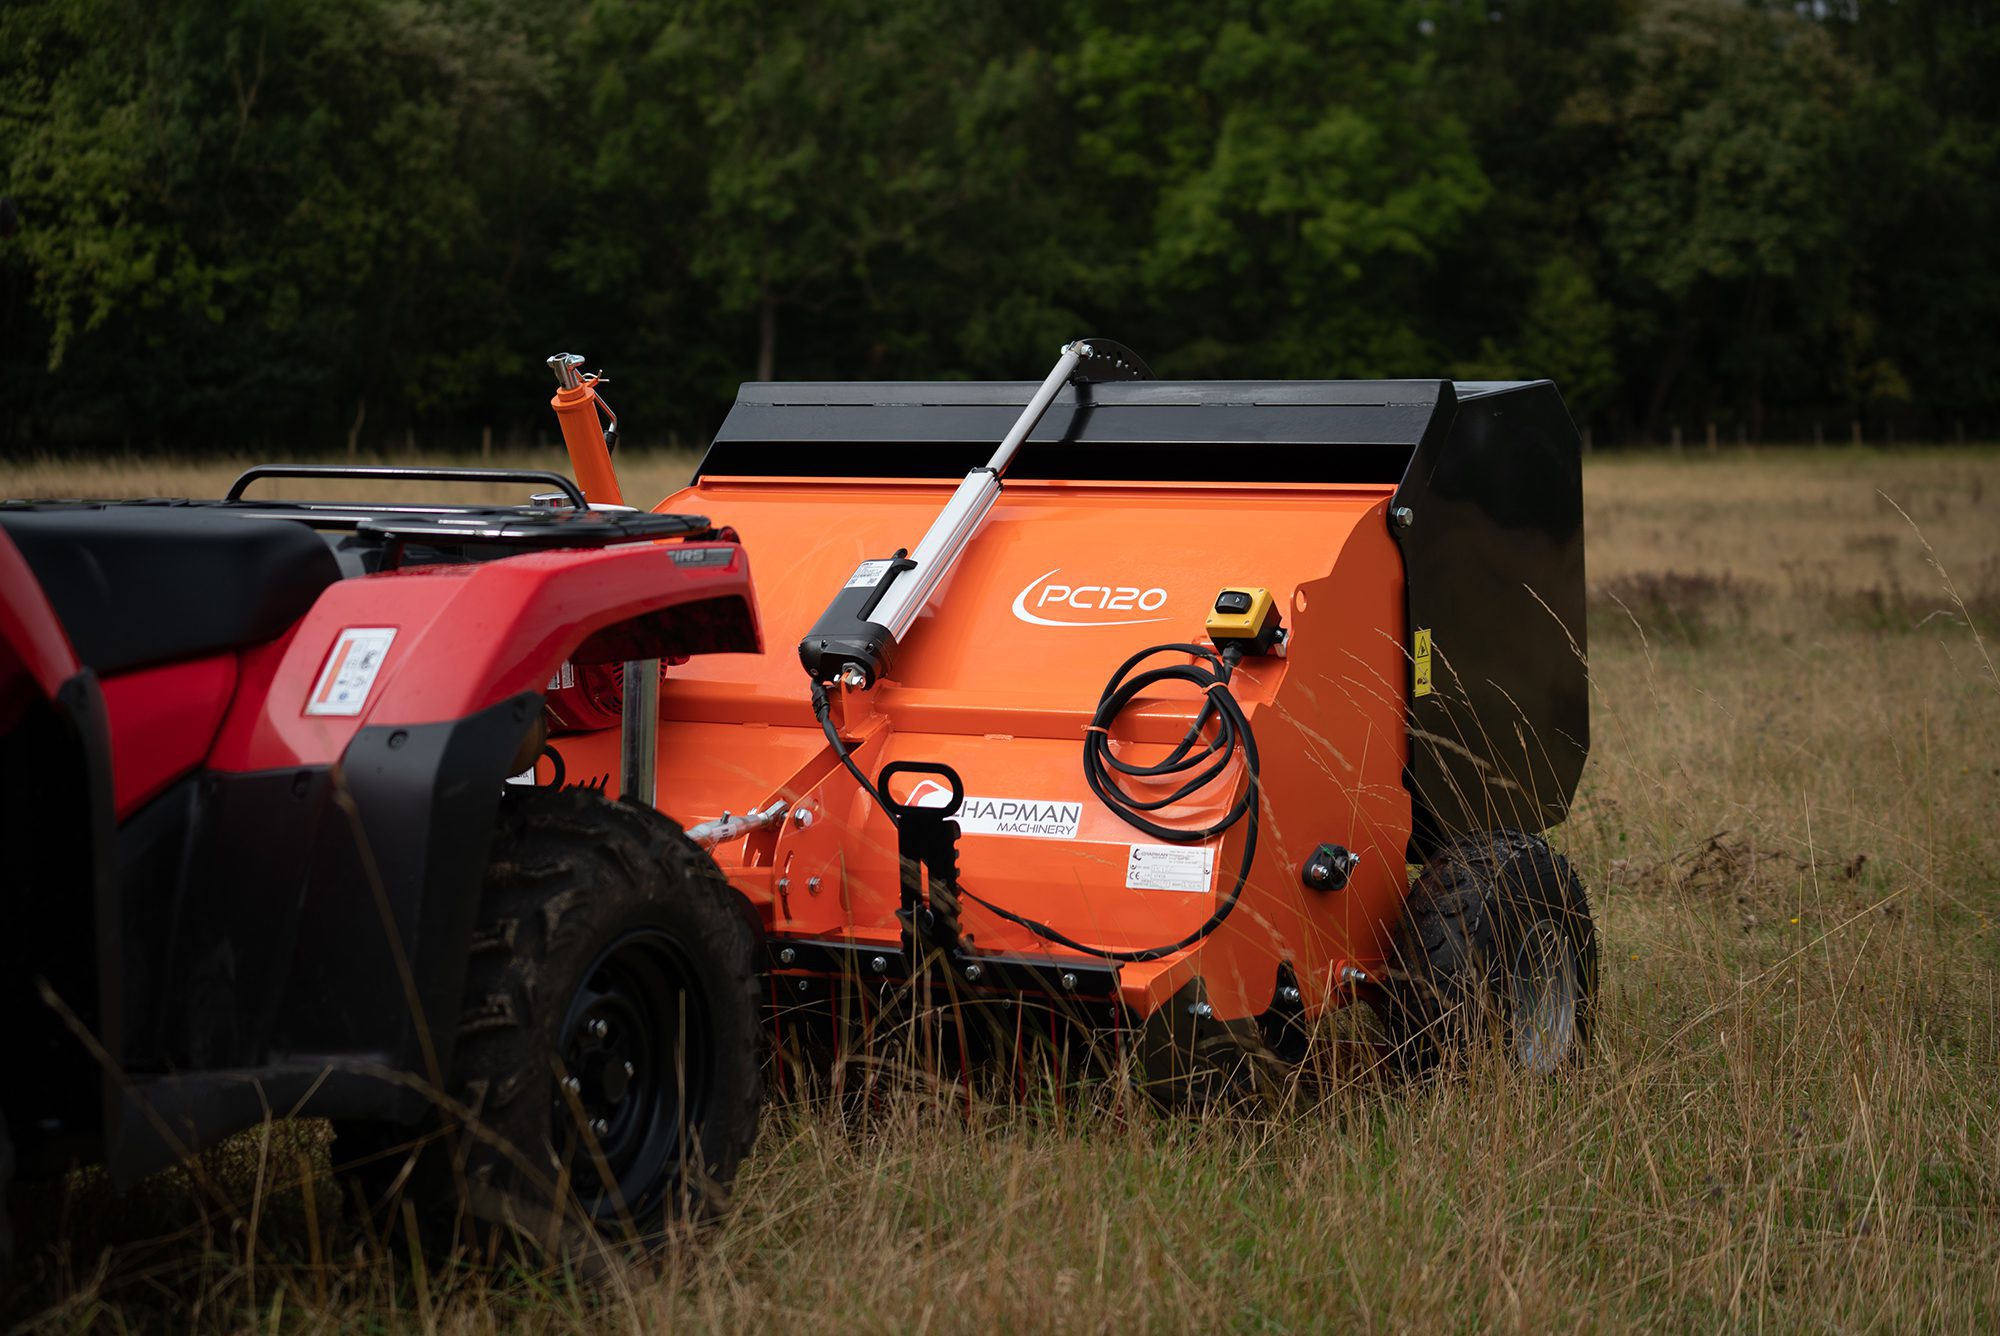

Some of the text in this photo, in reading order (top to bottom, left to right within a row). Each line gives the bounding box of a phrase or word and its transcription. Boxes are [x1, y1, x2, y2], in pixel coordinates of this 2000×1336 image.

[1037, 585, 1168, 611] PC120
[953, 801, 1080, 824] HAPMAN
[996, 822, 1075, 836] MACHINERY
